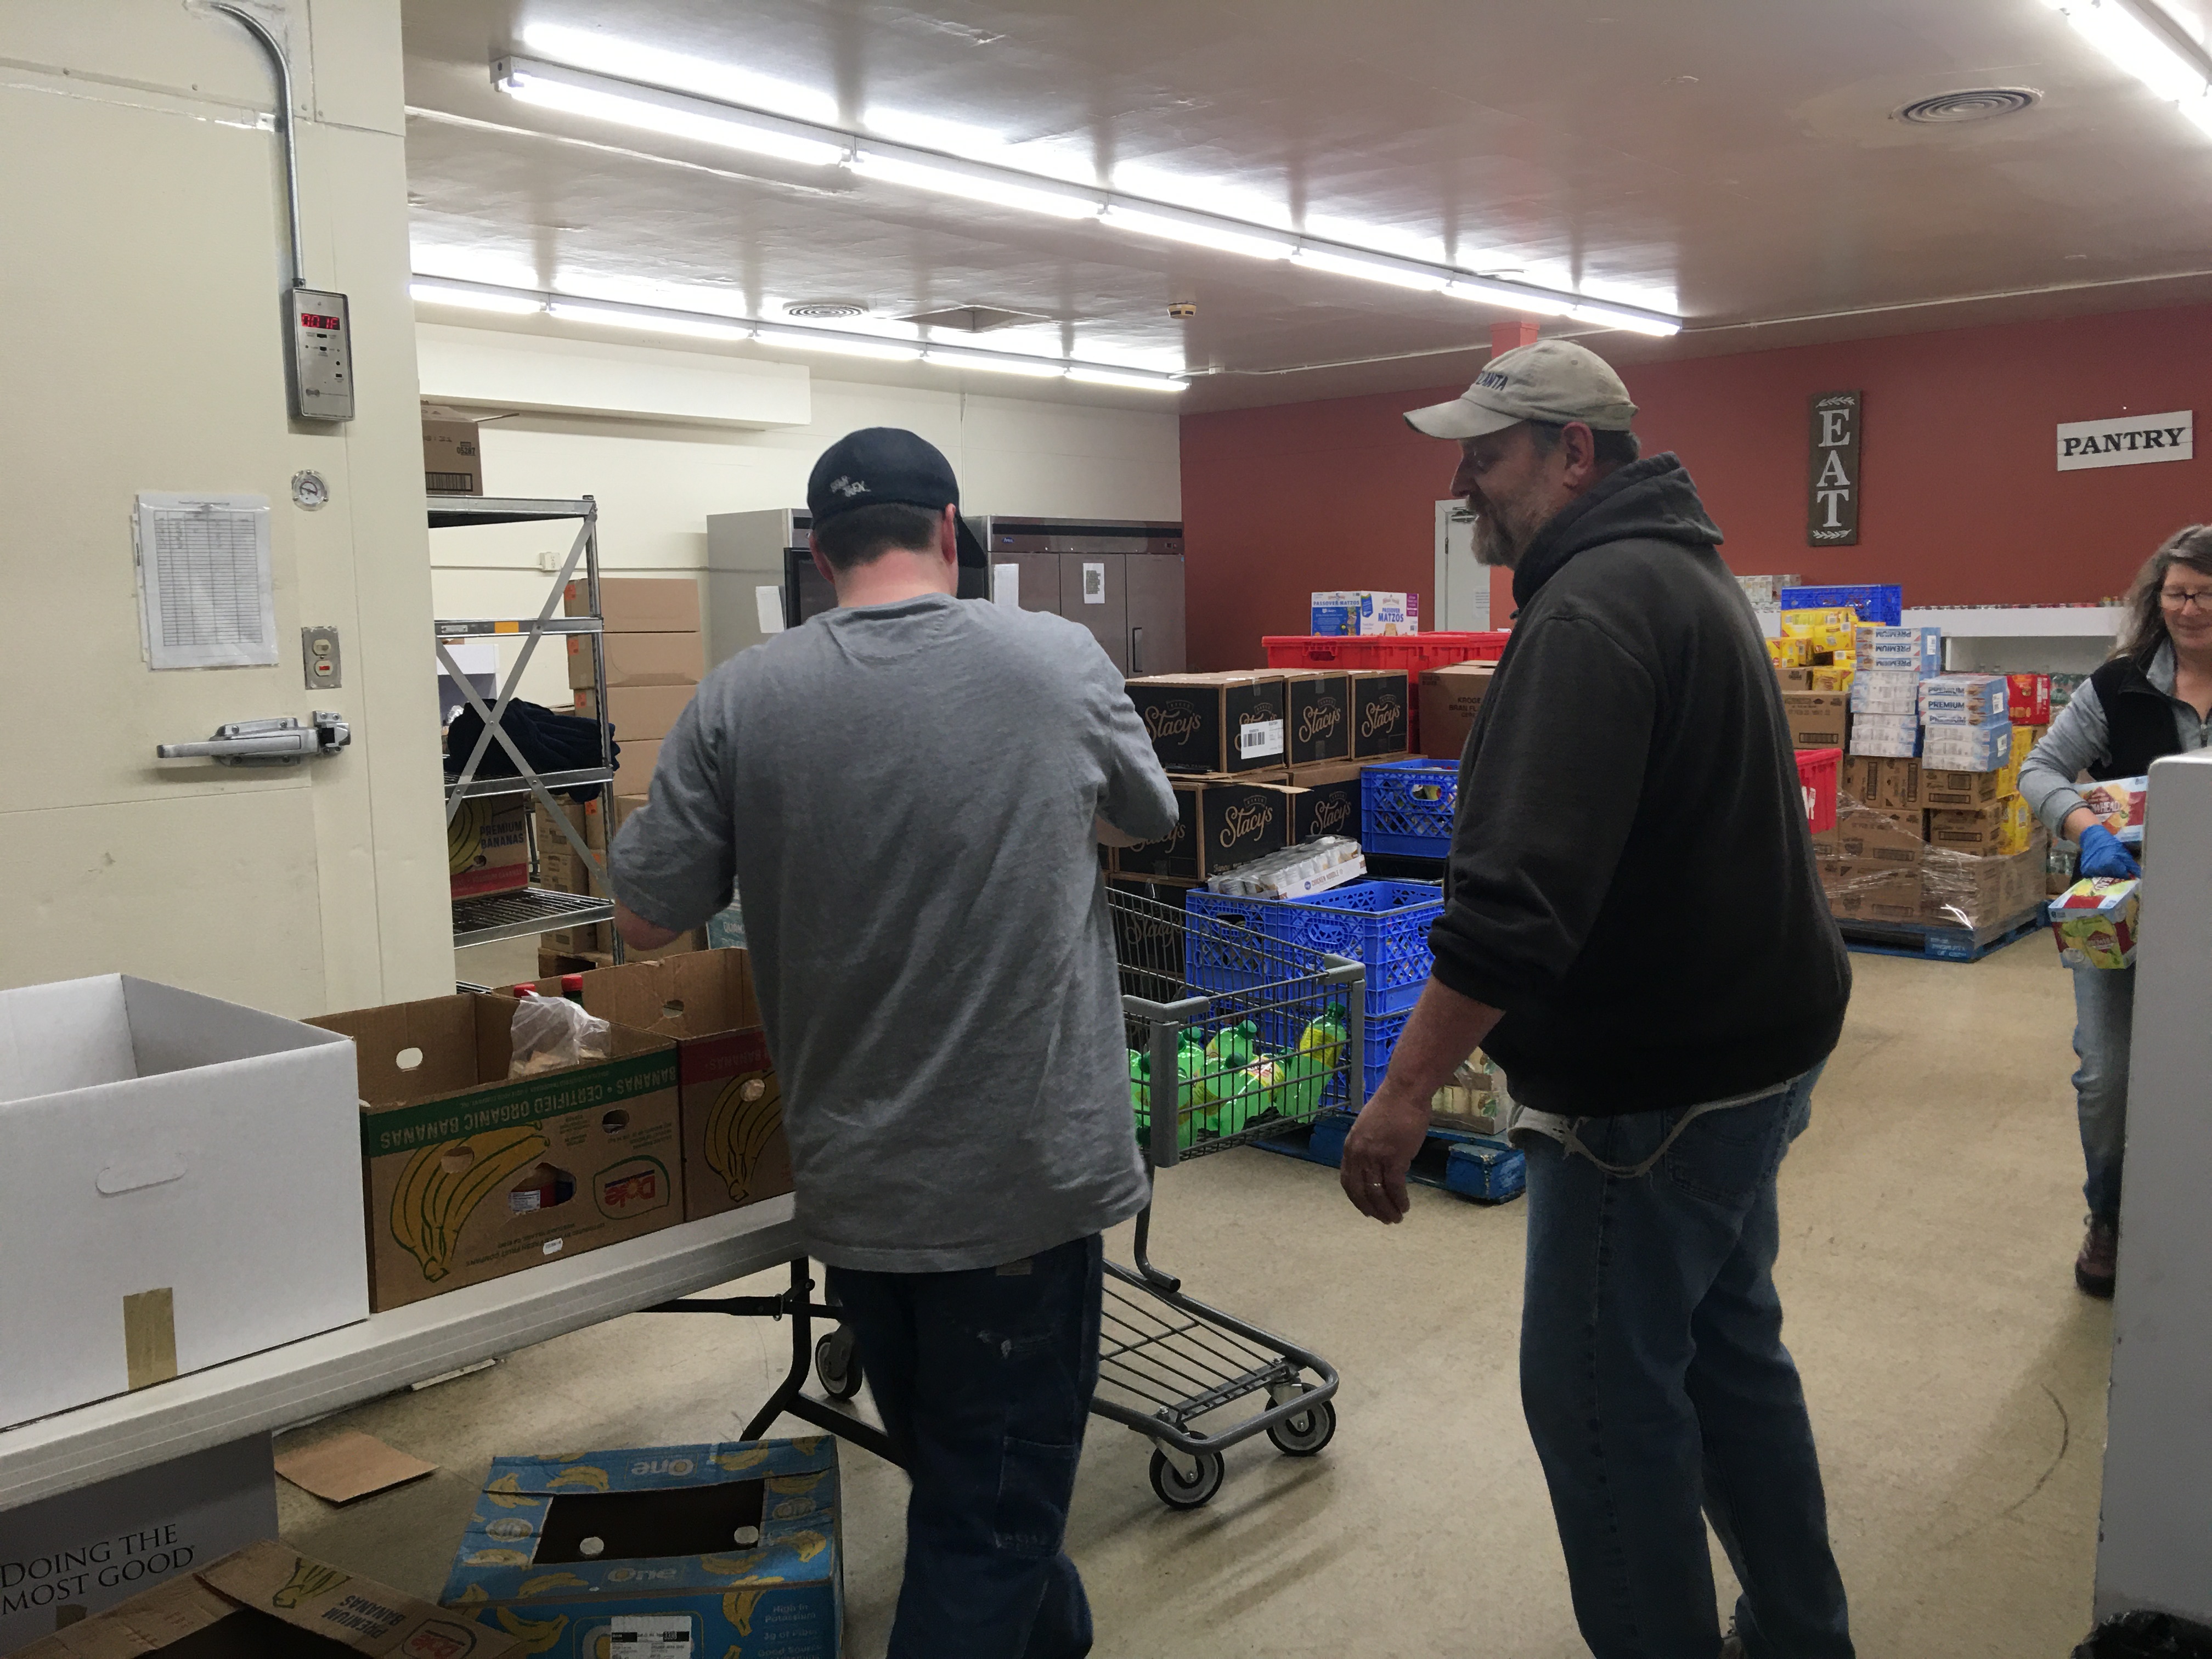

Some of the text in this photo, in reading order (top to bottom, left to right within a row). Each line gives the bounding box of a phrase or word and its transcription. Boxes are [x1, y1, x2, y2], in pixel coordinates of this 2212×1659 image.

[2063, 427, 2186, 456] PANTRY
[1816, 409, 1850, 527] EAT
[1378, 612, 1404, 622] MATZOS
[1145, 706, 1201, 746] Stacy's
[1299, 706, 1341, 743] Stacy's
[1362, 702, 1401, 737] Stacy's
[480, 821, 523, 836] PREMIUM
[1220, 806, 1273, 848] Stacy's
[1310, 800, 1352, 835] Stacy's
[481, 834, 523, 849] BANANAS
[1311, 875, 1326, 887] CHICKEN
[709, 1049, 761, 1070] BANANAS
[616, 1067, 676, 1096] BANANAS
[534, 1084, 603, 1115] CERTIFIED
[464, 1100, 530, 1129] ORGANIC
[380, 1118, 460, 1149] BANANAS
[605, 1174, 656, 1208] Dole
[465, 1253, 499, 1267] COMPANY
[501, 1247, 521, 1257] FRUIT
[522, 1240, 543, 1251] FRESH
[631, 1457, 696, 1476] One
[1, 1523, 178, 1588] DOING THE
[3, 1547, 194, 1615] MOST GOOD
[607, 1565, 677, 1582] One
[321, 1607, 388, 1640] PREMIUM
[340, 1595, 406, 1627] BANANAS
[765, 1612, 816, 1623] Potassium
[773, 1605, 795, 1614] High
[764, 1632, 776, 1640] 3g
[793, 1629, 817, 1637] Fiber
[758, 1646, 785, 1657] Good
